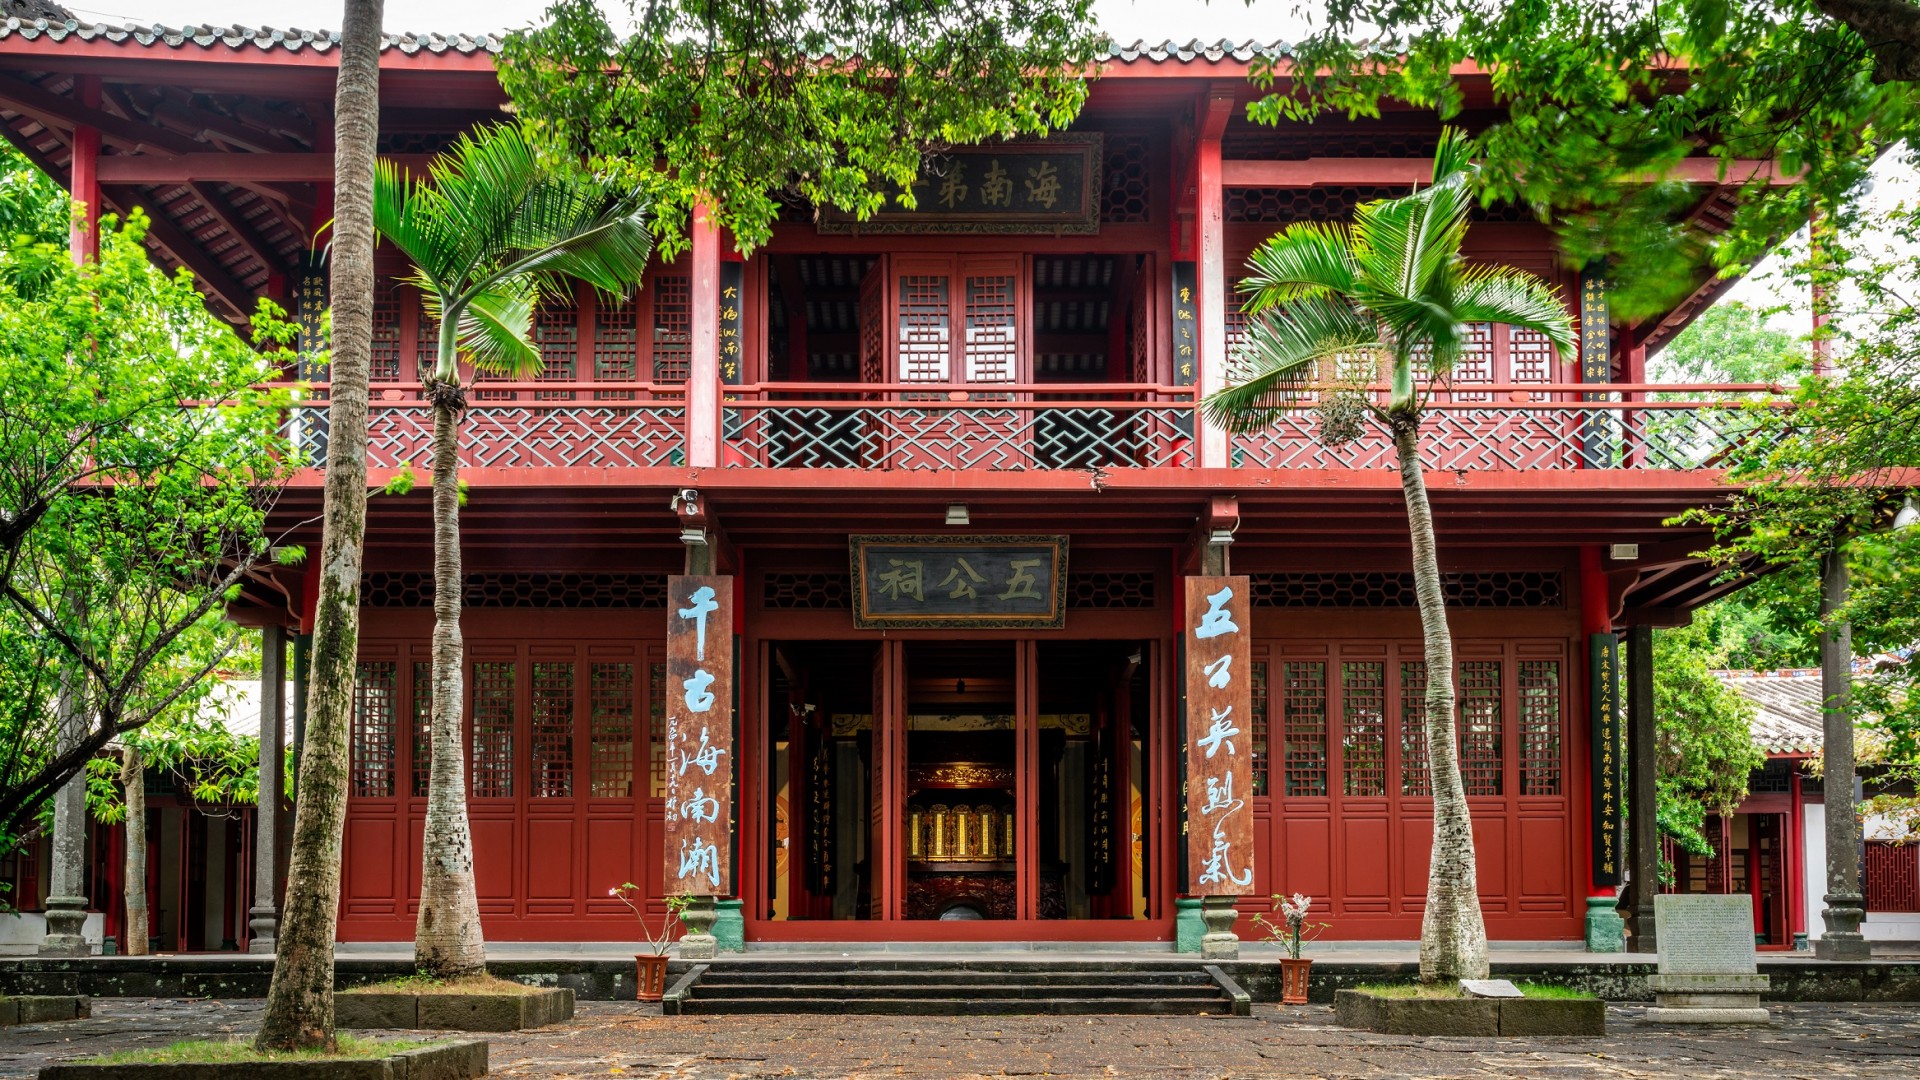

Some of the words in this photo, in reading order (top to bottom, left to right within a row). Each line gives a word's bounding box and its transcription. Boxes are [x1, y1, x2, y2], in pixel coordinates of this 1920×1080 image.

[864, 159, 1062, 210] 海南第一
[877, 556, 1043, 602] 五公祠
[678, 585, 726, 887] 千古海南潮
